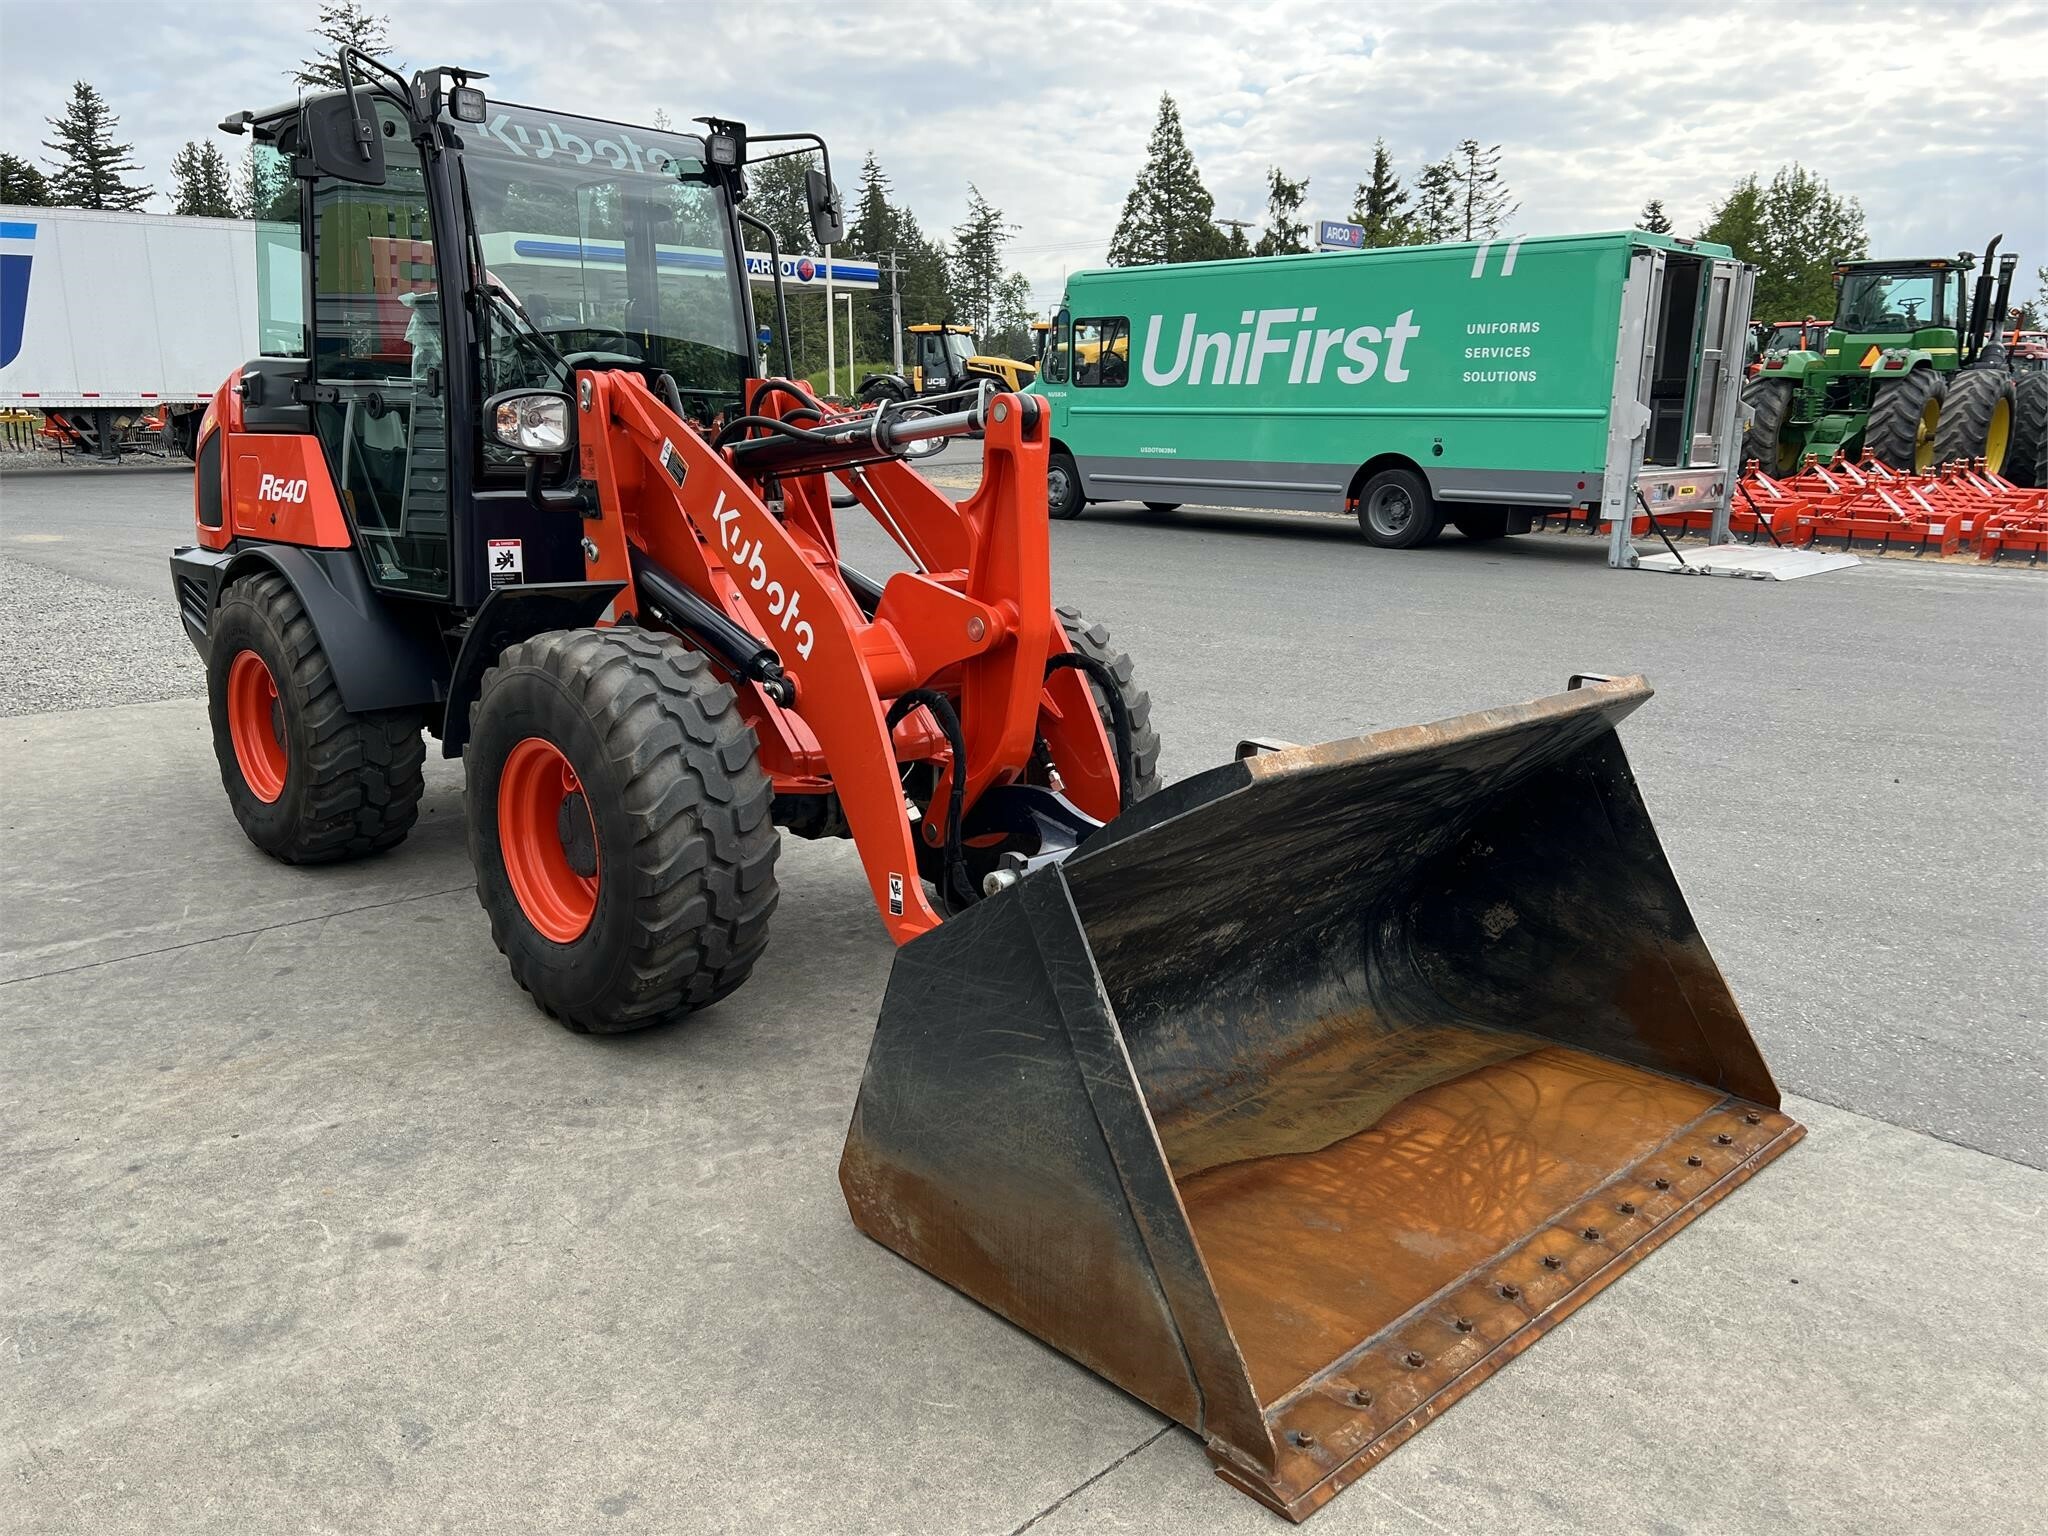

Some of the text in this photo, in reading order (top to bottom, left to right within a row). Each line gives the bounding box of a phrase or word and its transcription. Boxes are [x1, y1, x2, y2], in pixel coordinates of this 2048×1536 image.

[1326, 226, 1350, 241] ARCO
[1466, 321, 1540, 335] UNIFORMS
[1141, 306, 1421, 387] UniFirst
[1464, 346, 1531, 359] SERVICES
[926, 377, 946, 385] JCB
[1462, 370, 1537, 382] SOLUTIONS
[258, 473, 308, 504] R640
[712, 490, 815, 661] Kubota
